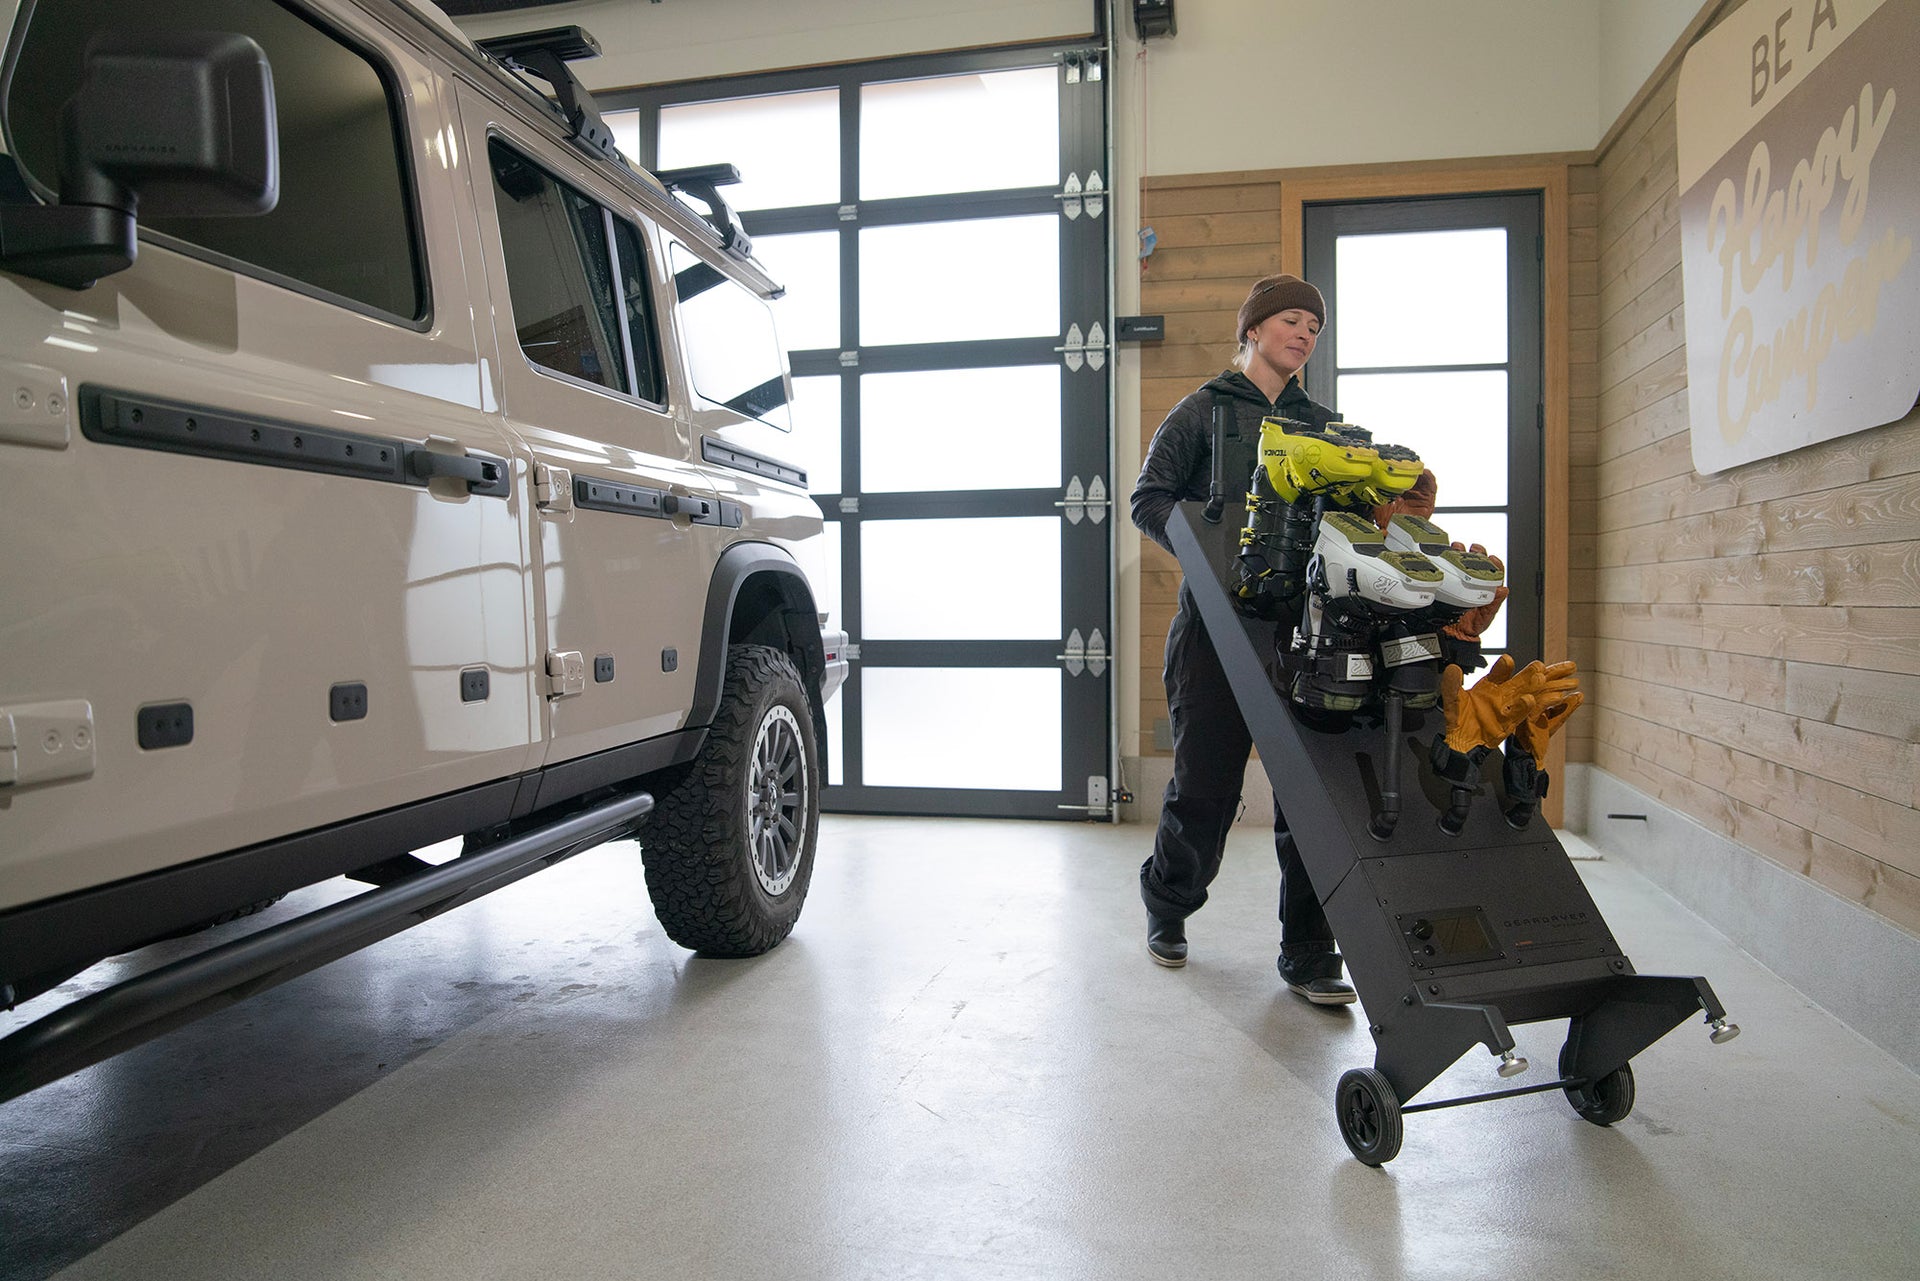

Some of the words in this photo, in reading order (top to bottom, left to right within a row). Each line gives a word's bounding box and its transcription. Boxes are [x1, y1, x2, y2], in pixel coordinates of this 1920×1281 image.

[1751, 7, 1793, 108] BE
[1807, 0, 1837, 52] A
[1707, 82, 1897, 320] Happy
[1717, 226, 1913, 443] Camper
[1372, 575, 1399, 595] K2
